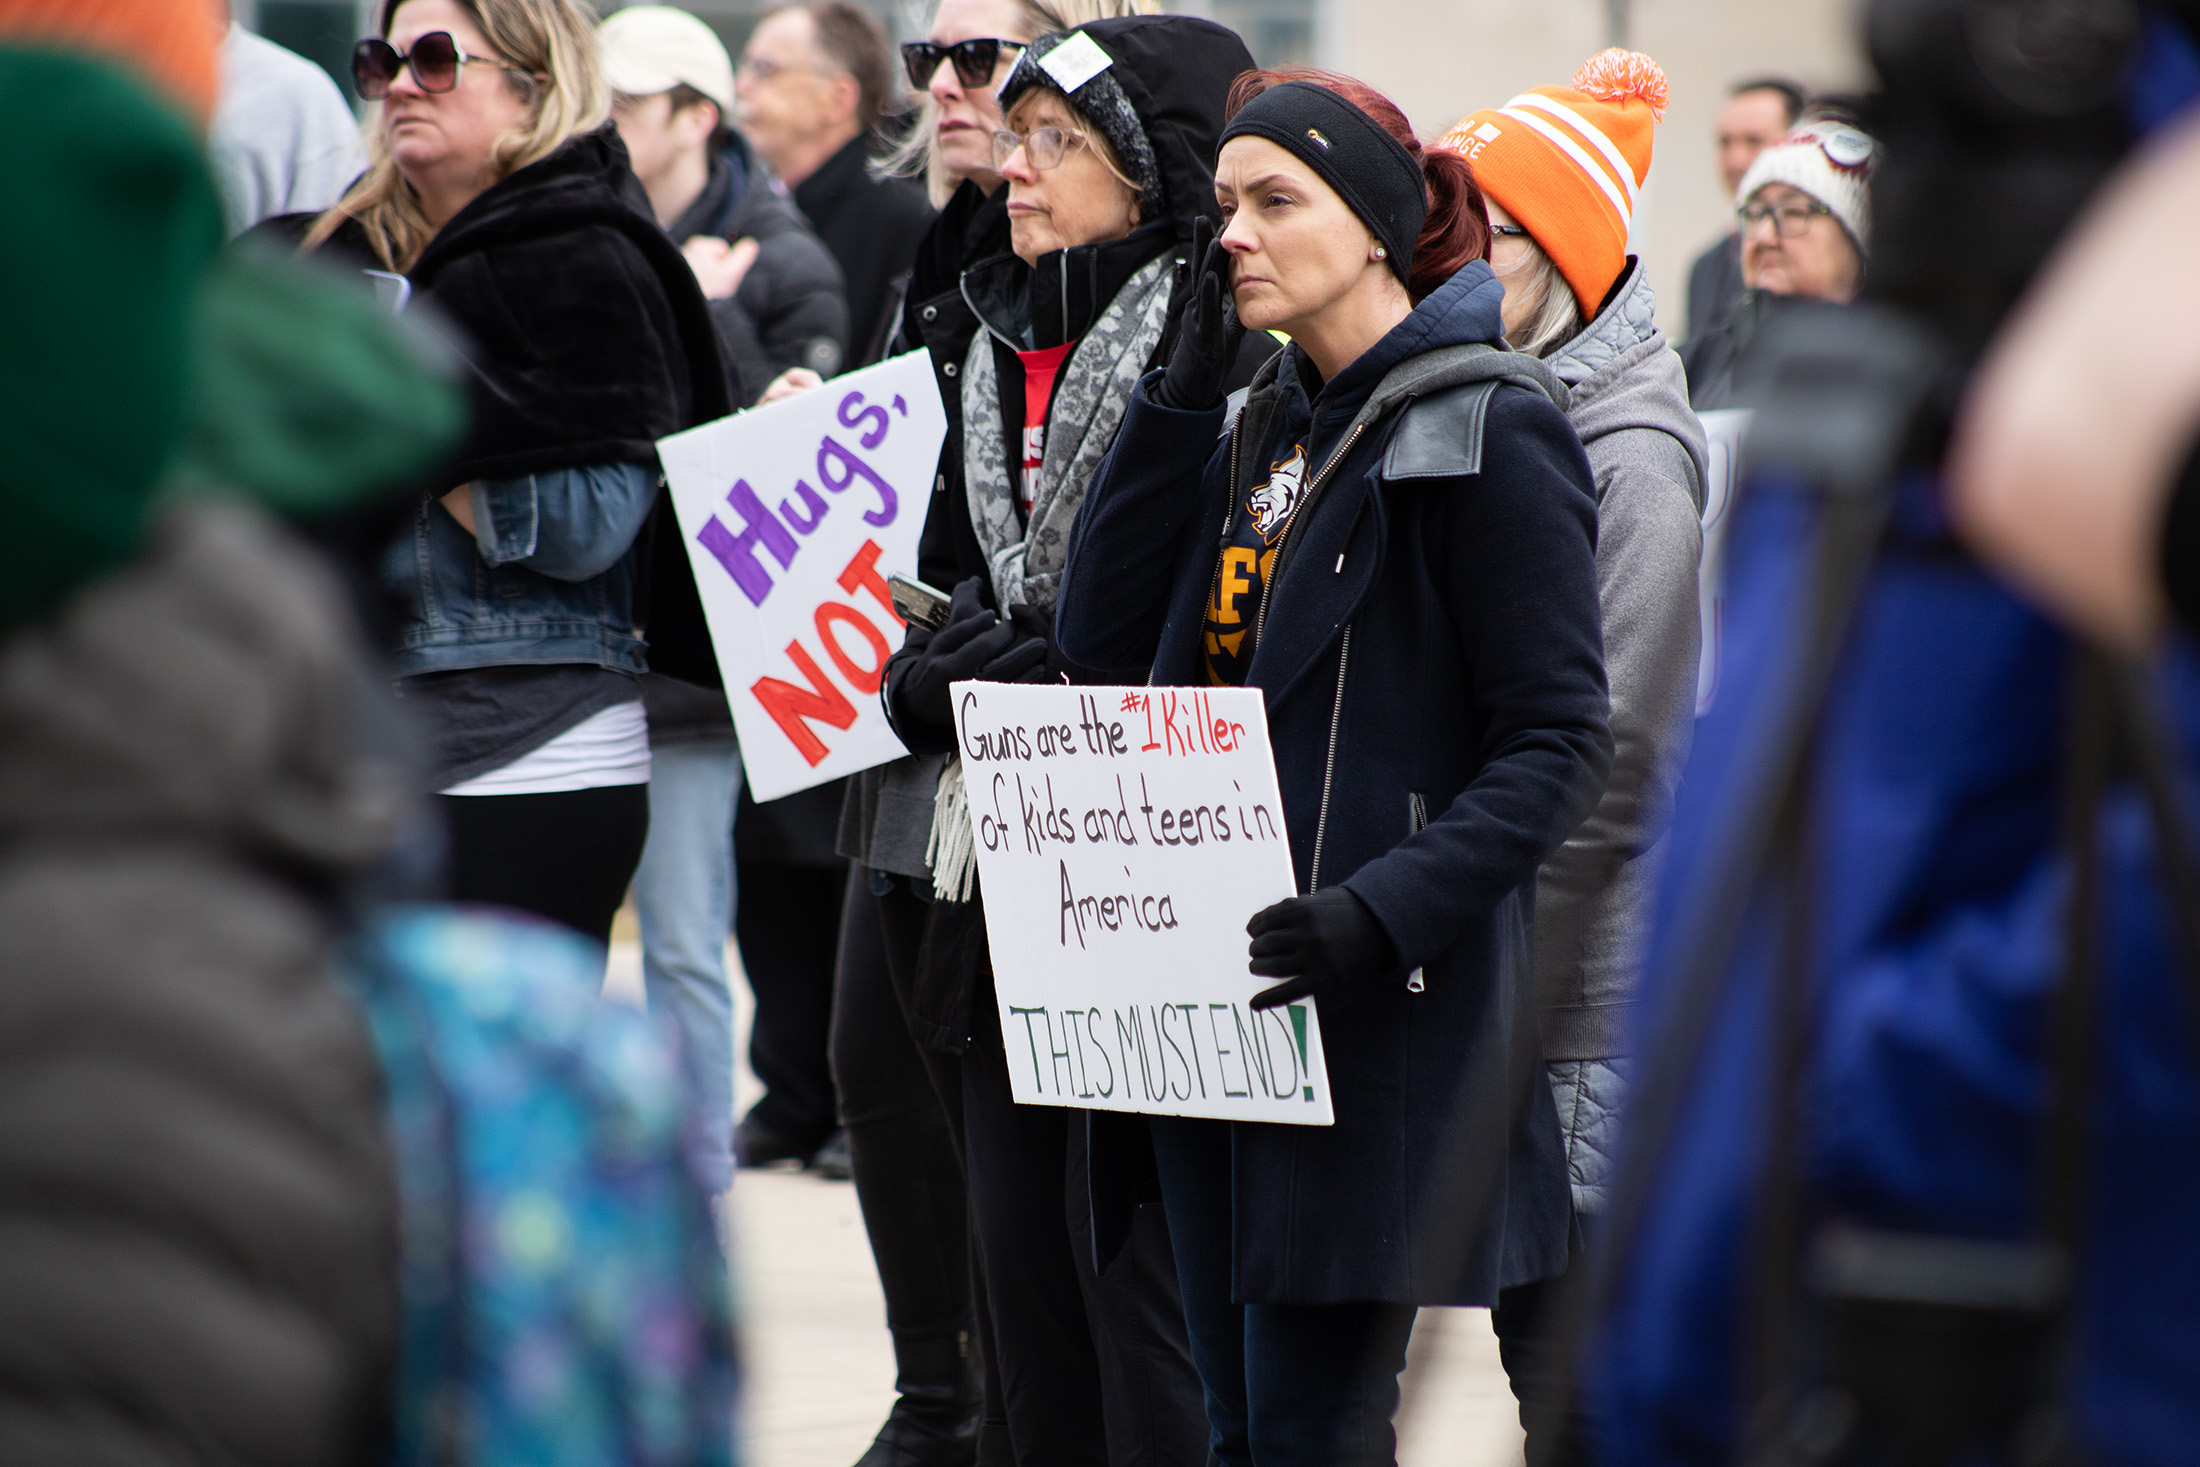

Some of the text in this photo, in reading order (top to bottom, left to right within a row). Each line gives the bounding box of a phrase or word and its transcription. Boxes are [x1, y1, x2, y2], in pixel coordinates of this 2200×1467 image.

[696, 391, 907, 607] Hugs,
[750, 539, 907, 768] NOT
[960, 691, 1031, 762] Guns
[1036, 724, 1077, 758] are
[1080, 694, 1128, 757] the
[1161, 691, 1246, 757] Killer
[980, 772, 1277, 856] of kids and teens in
[1060, 859, 1178, 950] America
[1010, 1002, 1315, 1103] THIS MUST END!
